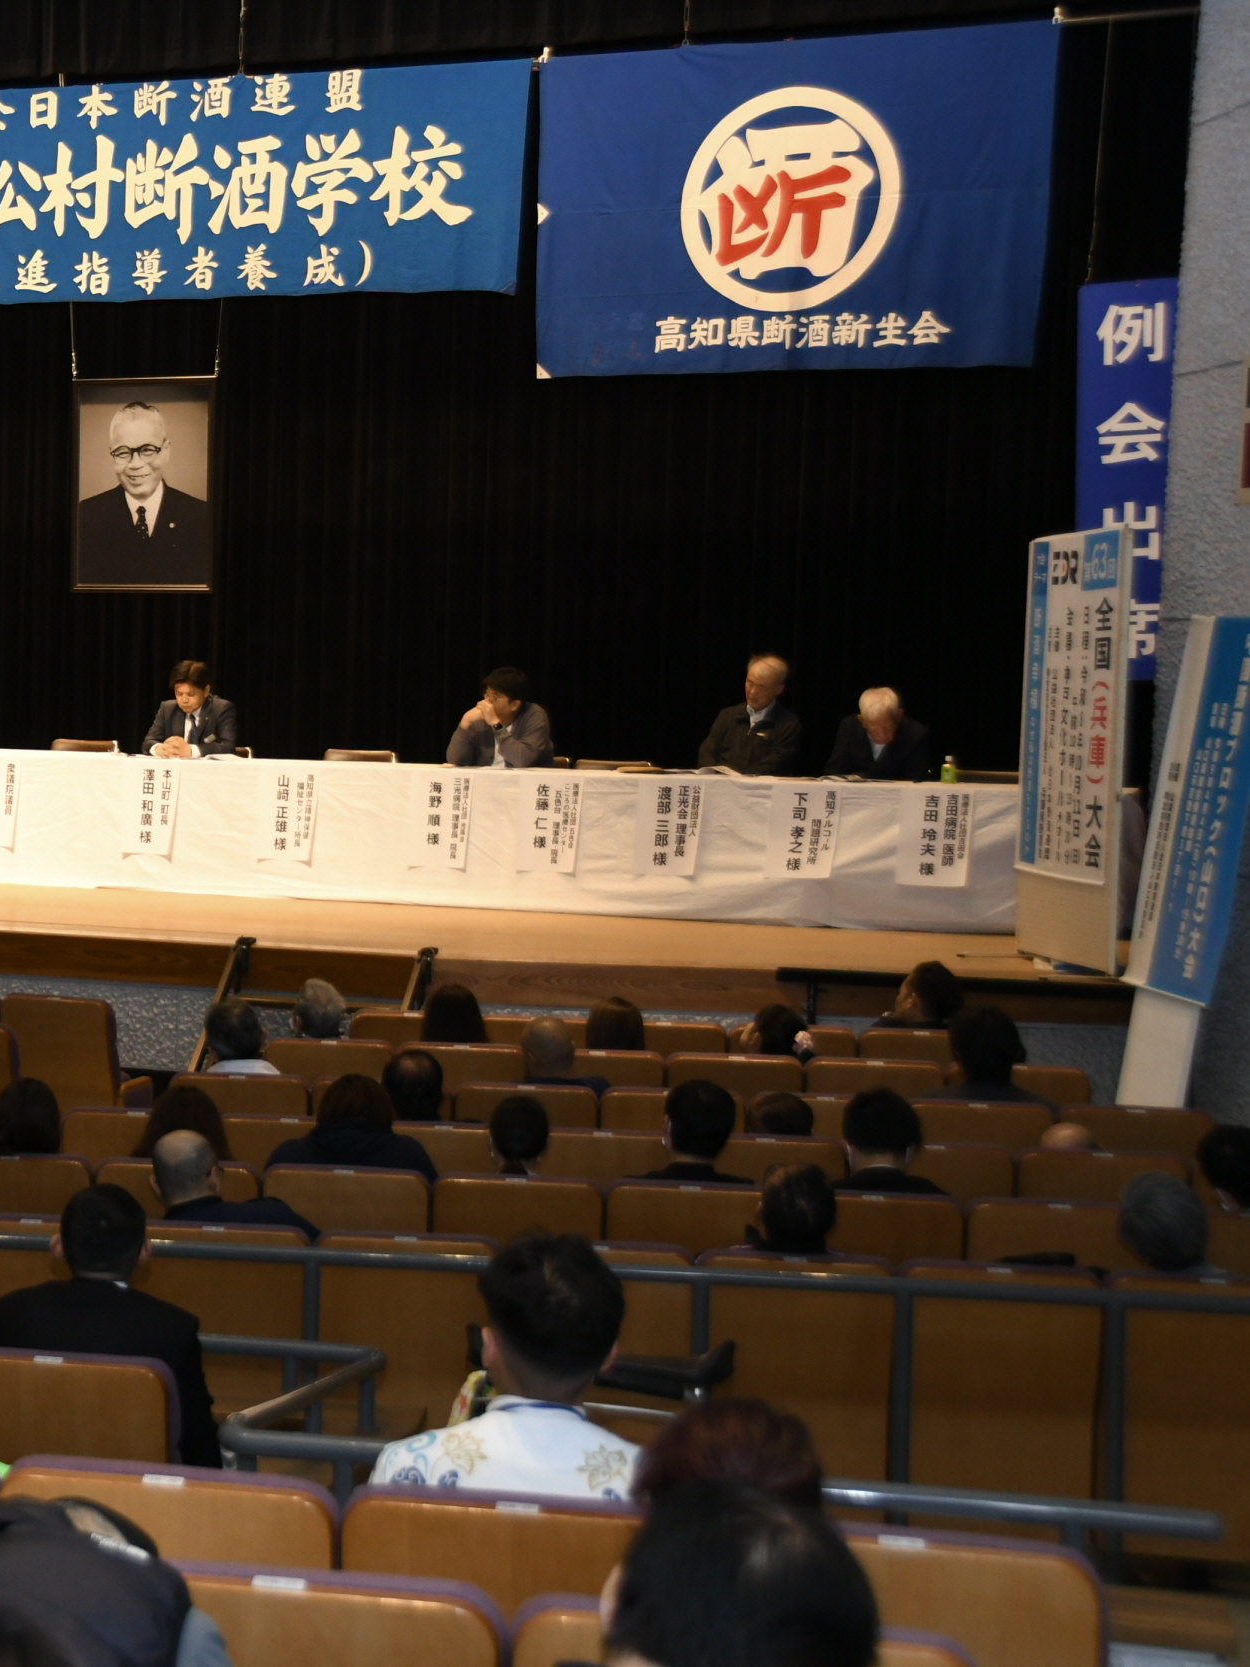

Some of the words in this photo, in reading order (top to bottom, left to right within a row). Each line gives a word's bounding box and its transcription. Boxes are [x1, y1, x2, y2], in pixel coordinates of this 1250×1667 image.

[653, 310, 951, 354] 高知県断酒新生会
